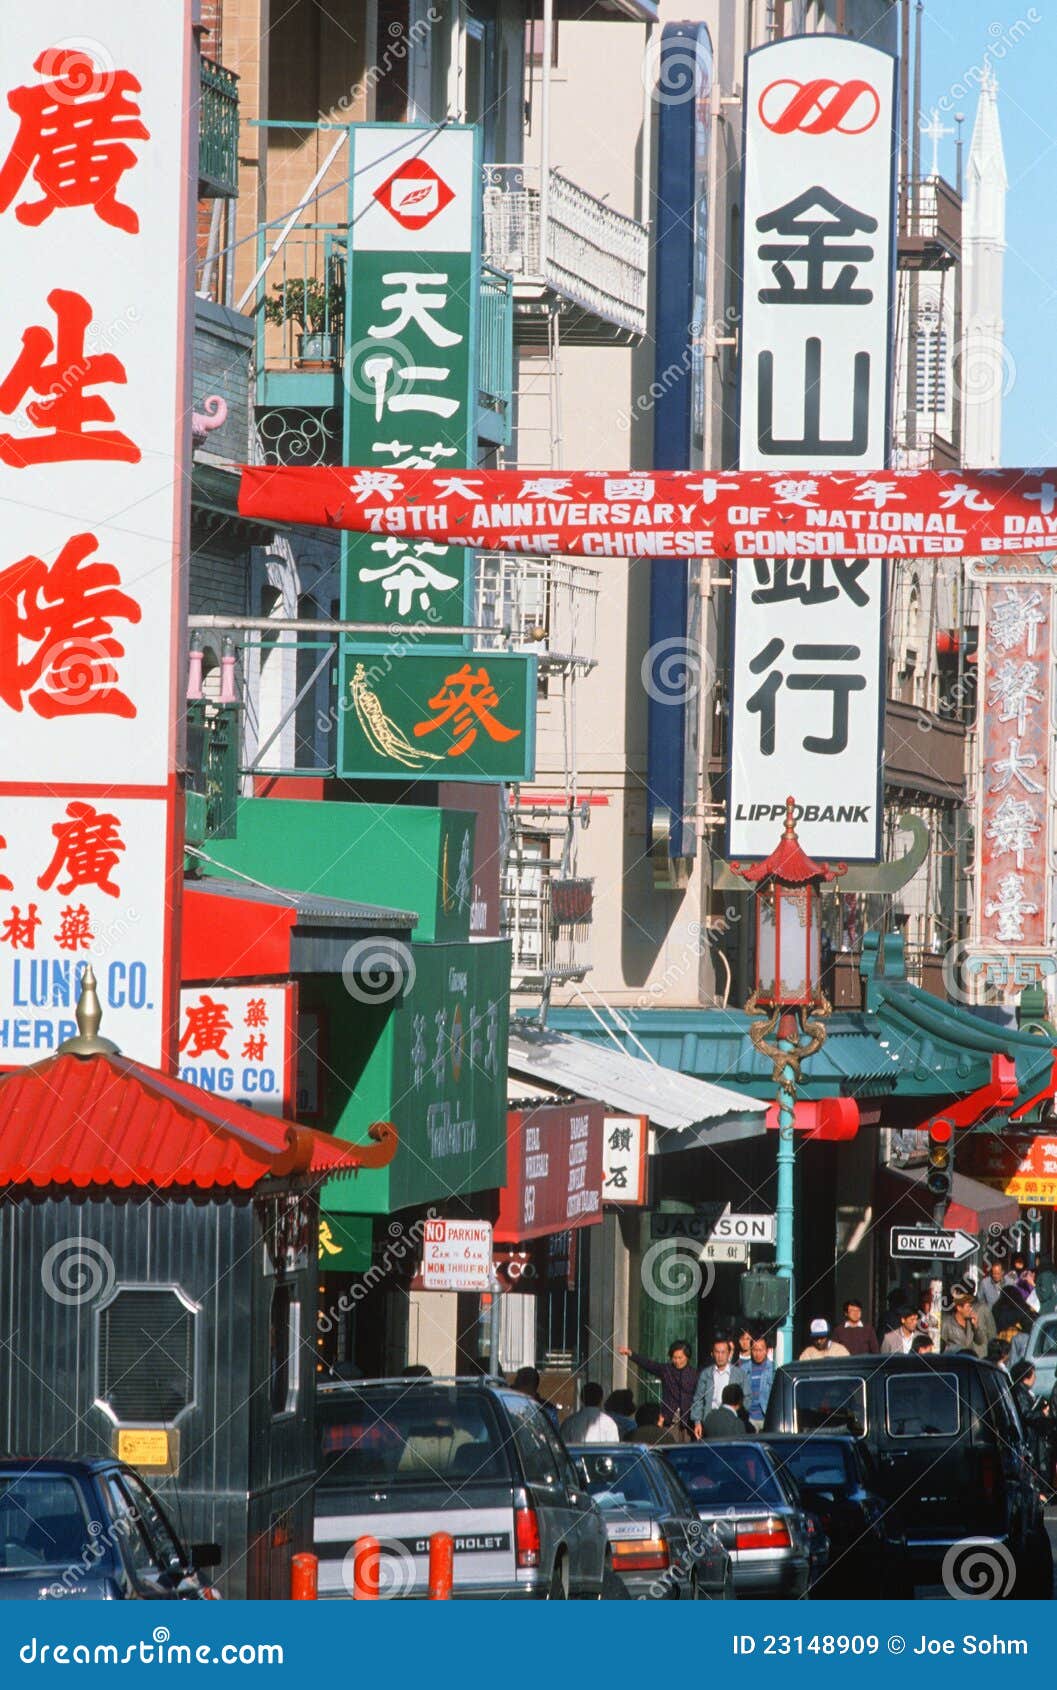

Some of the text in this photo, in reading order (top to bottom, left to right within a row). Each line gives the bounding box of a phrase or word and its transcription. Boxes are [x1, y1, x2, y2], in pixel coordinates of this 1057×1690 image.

[364, 503, 1057, 535] 79TH ANNIVERSARY OF NATIONAL DAY
[500, 533, 559, 554] THE
[582, 531, 714, 556] CHINESE
[734, 530, 964, 555] CONSOLIDATED
[108, 960, 154, 1009] CO.
[180, 1066, 279, 1093] ONG CO.
[605, 1127, 633, 1188] 鑽石
[426, 1222, 486, 1241] NO PARKING
[655, 1219, 766, 1237] JACKSON
[900, 1237, 953, 1250] ONE WAY
[415, 1537, 502, 1552] CROLET
